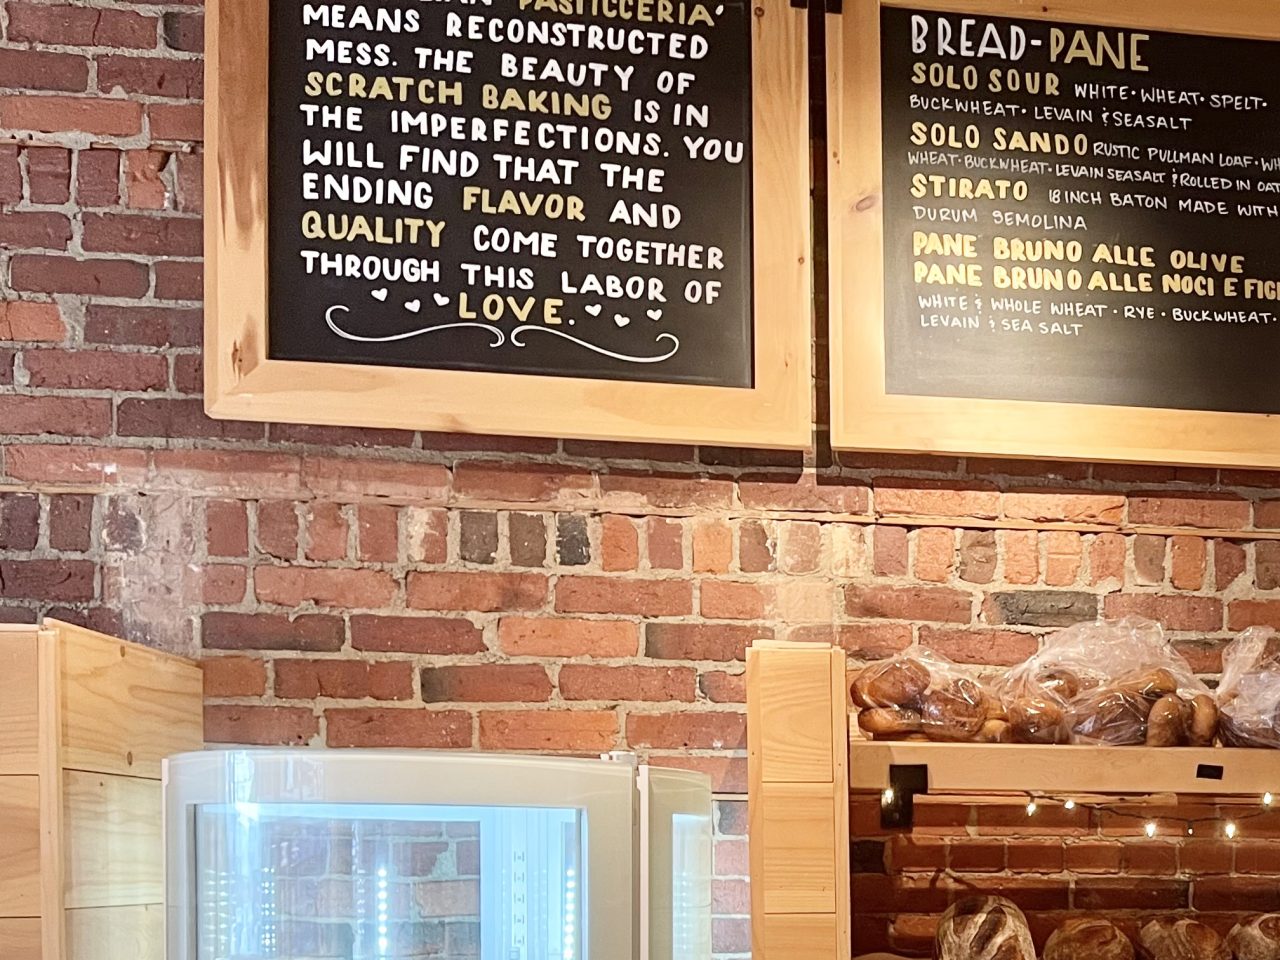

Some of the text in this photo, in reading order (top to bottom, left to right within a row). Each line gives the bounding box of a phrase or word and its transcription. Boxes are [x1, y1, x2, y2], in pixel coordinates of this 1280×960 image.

[304, 6, 707, 59] MEANS RECONSTRUCTED
[910, 15, 1150, 71] BREAD-PANE
[305, 39, 695, 95] MESS. THE BEAUTY OF
[911, 62, 1060, 96] SOLO SOUR
[305, 72, 709, 127] SCRATCH BAKING IS IN
[1034, 106, 1093, 122] LEVAIN
[300, 105, 744, 164] THE IMPERFECTIONS. YOU
[910, 121, 980, 149] SOLO
[992, 127, 1088, 156] SANDO
[1093, 141, 1140, 160] RUSTIC
[1148, 147, 1214, 165] PULLMAN
[303, 139, 664, 192] WILL FIND THAT THE
[1055, 163, 1104, 180] LEVAIN
[1180, 173, 1232, 190] ROLLED
[1236, 179, 1251, 191] IN
[303, 174, 681, 228] ENDING FLAVOR AND
[910, 172, 1028, 201] STIRATO
[1065, 190, 1102, 205] INCH
[1109, 192, 1167, 209] BATON
[1179, 198, 1229, 215] MADE
[1237, 204, 1278, 218] WITH
[302, 210, 724, 270] QUALITY COME TOGETHER
[912, 205, 1087, 231] DURUM SEMOLINA
[912, 230, 1245, 274] PANE BRUNO ALLE OLIVE
[300, 251, 721, 304] THROUGH THIS LABOR OF
[913, 261, 983, 287] PANE
[992, 265, 1082, 291] BRUNO
[1087, 270, 1153, 293] ALLE
[1162, 273, 1214, 297] NOCI
[1224, 277, 1239, 297] E
[459, 292, 575, 325] LOVE.
[918, 295, 968, 311] WHITE
[991, 298, 1041, 314] WHOLE
[1050, 302, 1108, 318] WHEAT
[1124, 305, 1155, 320] RYE
[920, 314, 1083, 336] LEVAIN SEA SALT
